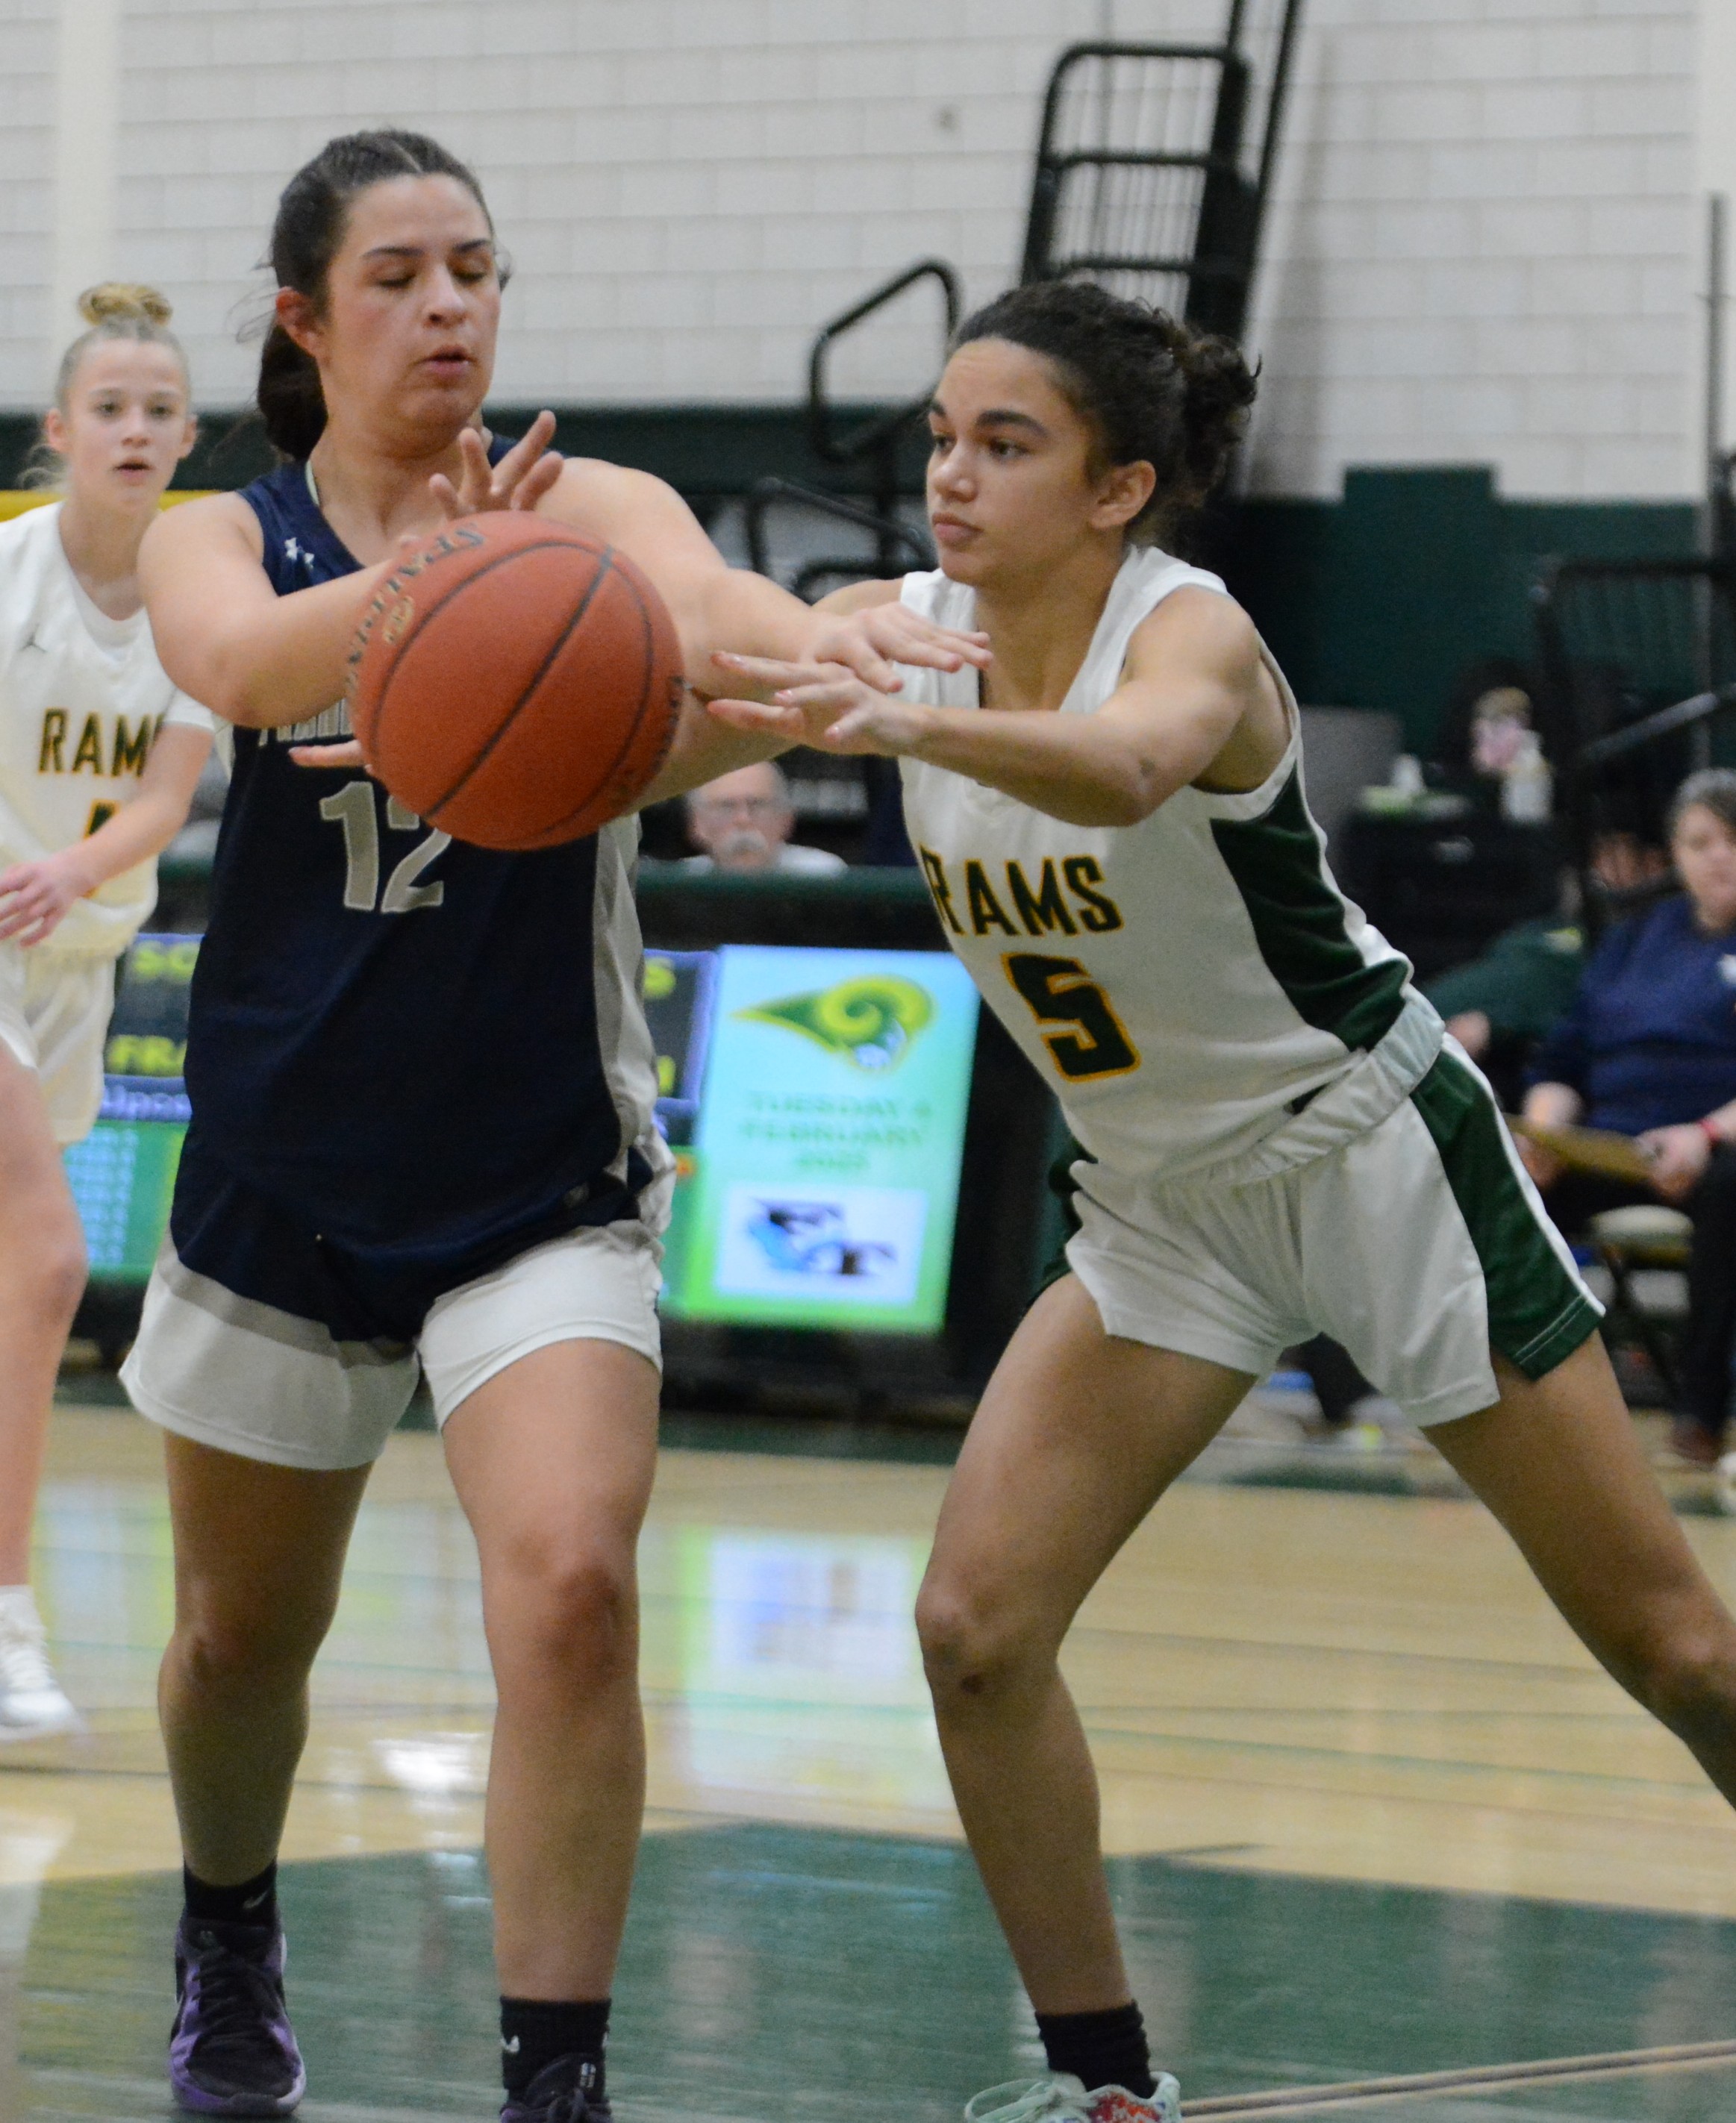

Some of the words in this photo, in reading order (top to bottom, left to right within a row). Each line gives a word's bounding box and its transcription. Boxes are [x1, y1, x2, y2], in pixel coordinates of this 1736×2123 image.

[38, 707, 166, 778] RAM
[319, 781, 452, 914] 12
[919, 844, 1125, 937] RAMS
[1000, 951, 1142, 1084] 5
